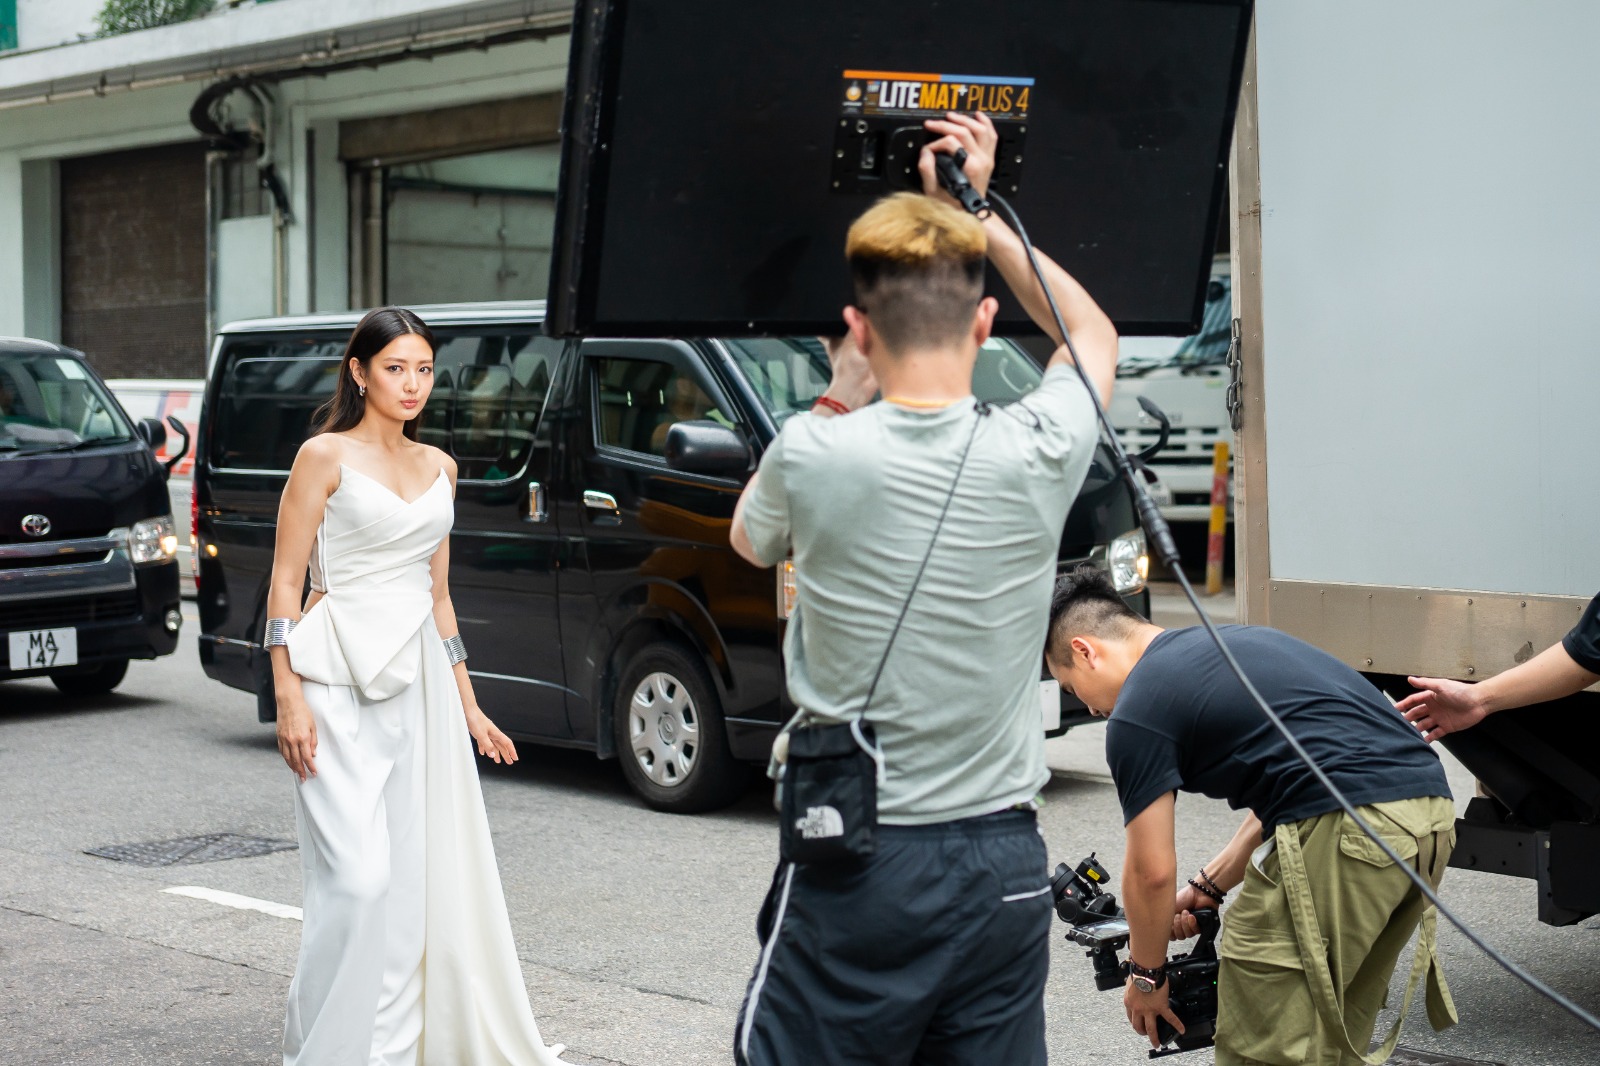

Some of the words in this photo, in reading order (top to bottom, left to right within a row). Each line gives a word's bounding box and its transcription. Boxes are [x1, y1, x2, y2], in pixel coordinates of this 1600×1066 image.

[967, 84, 1013, 112] PLUS
[1016, 86, 1030, 113] 4
[29, 630, 57, 649] MA
[27, 648, 59, 668] 147
